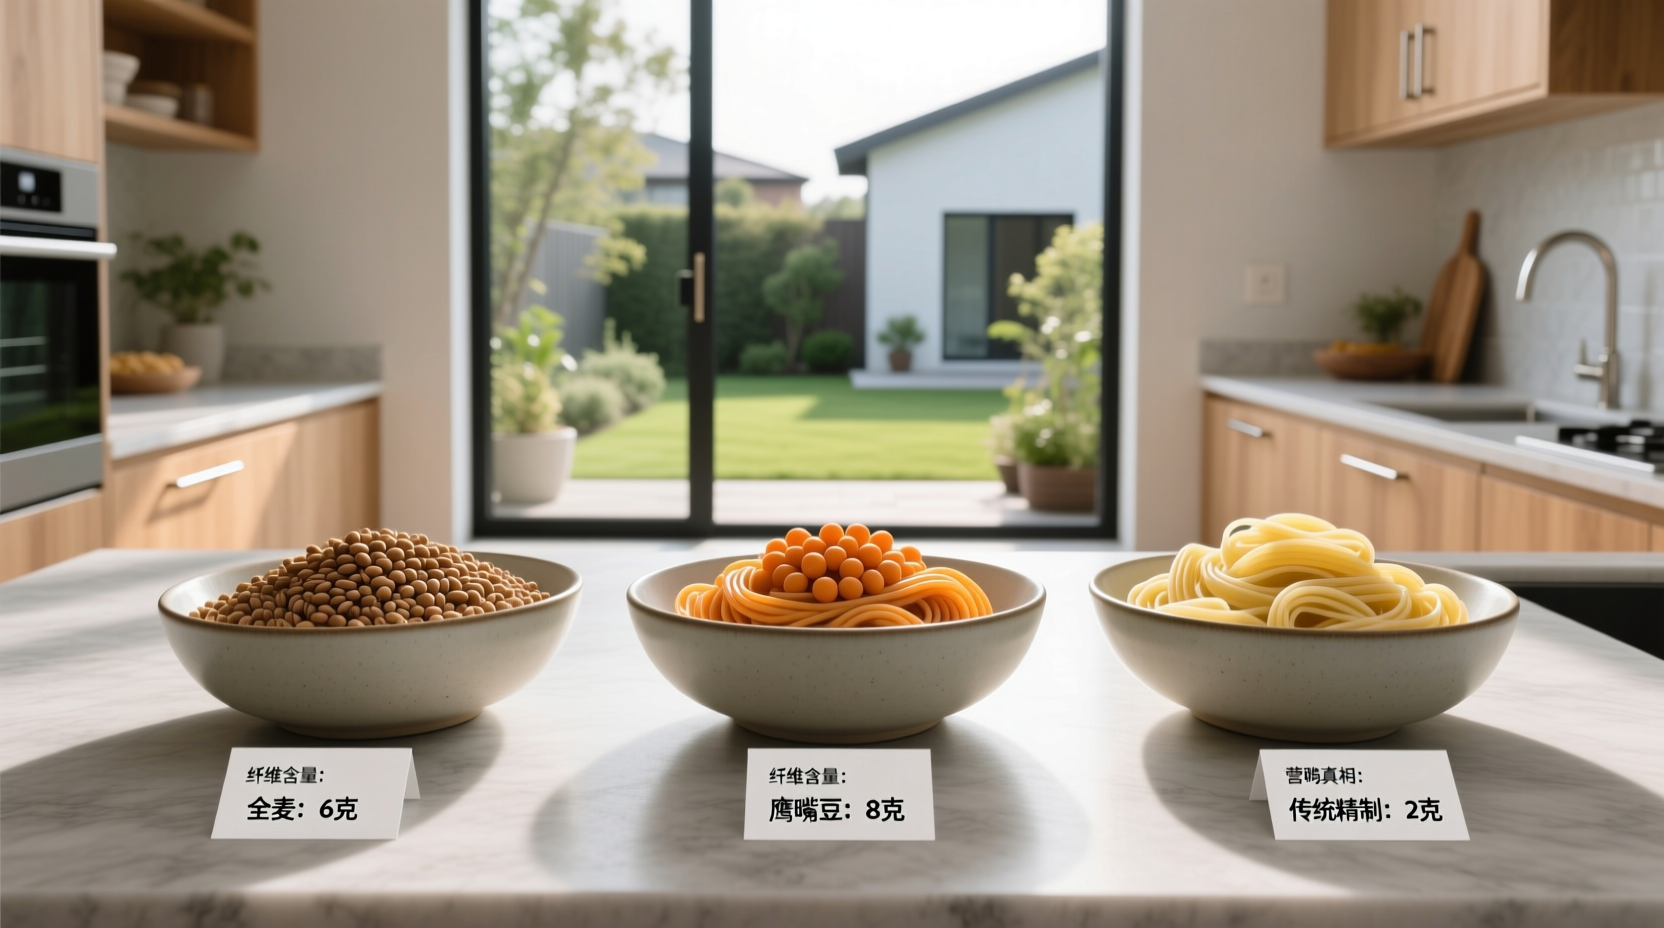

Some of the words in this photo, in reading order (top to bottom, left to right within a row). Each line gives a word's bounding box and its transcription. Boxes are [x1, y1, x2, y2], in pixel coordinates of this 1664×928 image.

[246, 765, 324, 784] 纤维含量：
[769, 766, 847, 785] 纤维含量：
[247, 796, 359, 821] 全麦：6克
[769, 796, 906, 823] 鹰嘴豆：8克
[1289, 797, 1443, 823] 传统精制：2克
